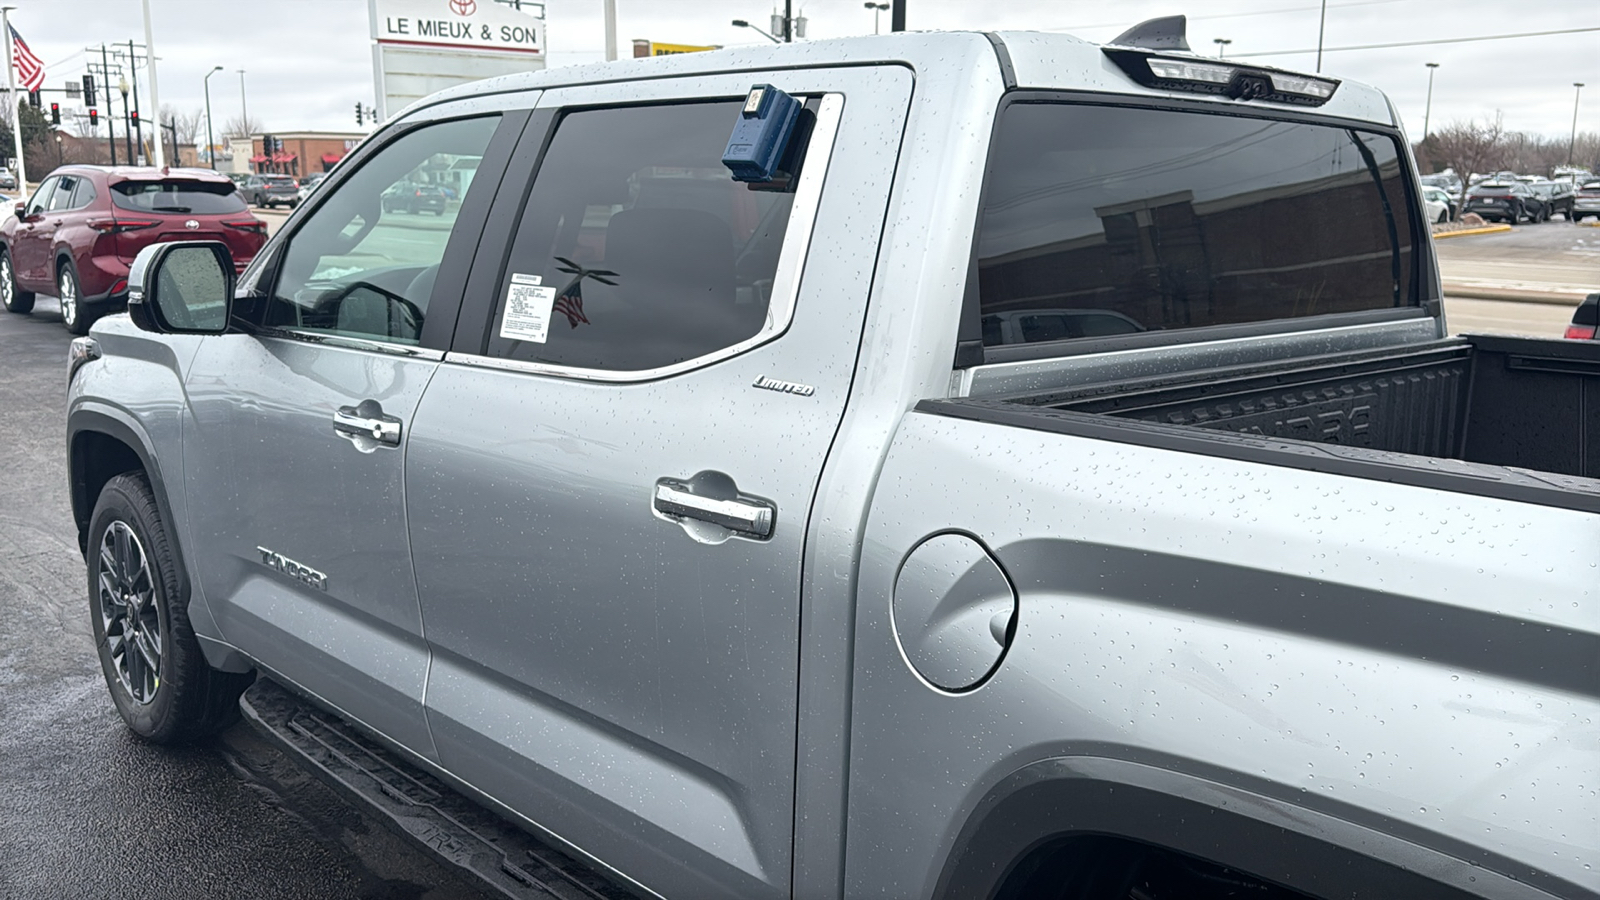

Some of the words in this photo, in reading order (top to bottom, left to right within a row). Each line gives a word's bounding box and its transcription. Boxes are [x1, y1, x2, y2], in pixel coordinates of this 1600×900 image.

[387, 17, 409, 34] LE
[417, 19, 473, 39] MIEUX
[480, 24, 492, 40] &
[500, 25, 536, 44] SON
[256, 545, 328, 591] TUNDRA
